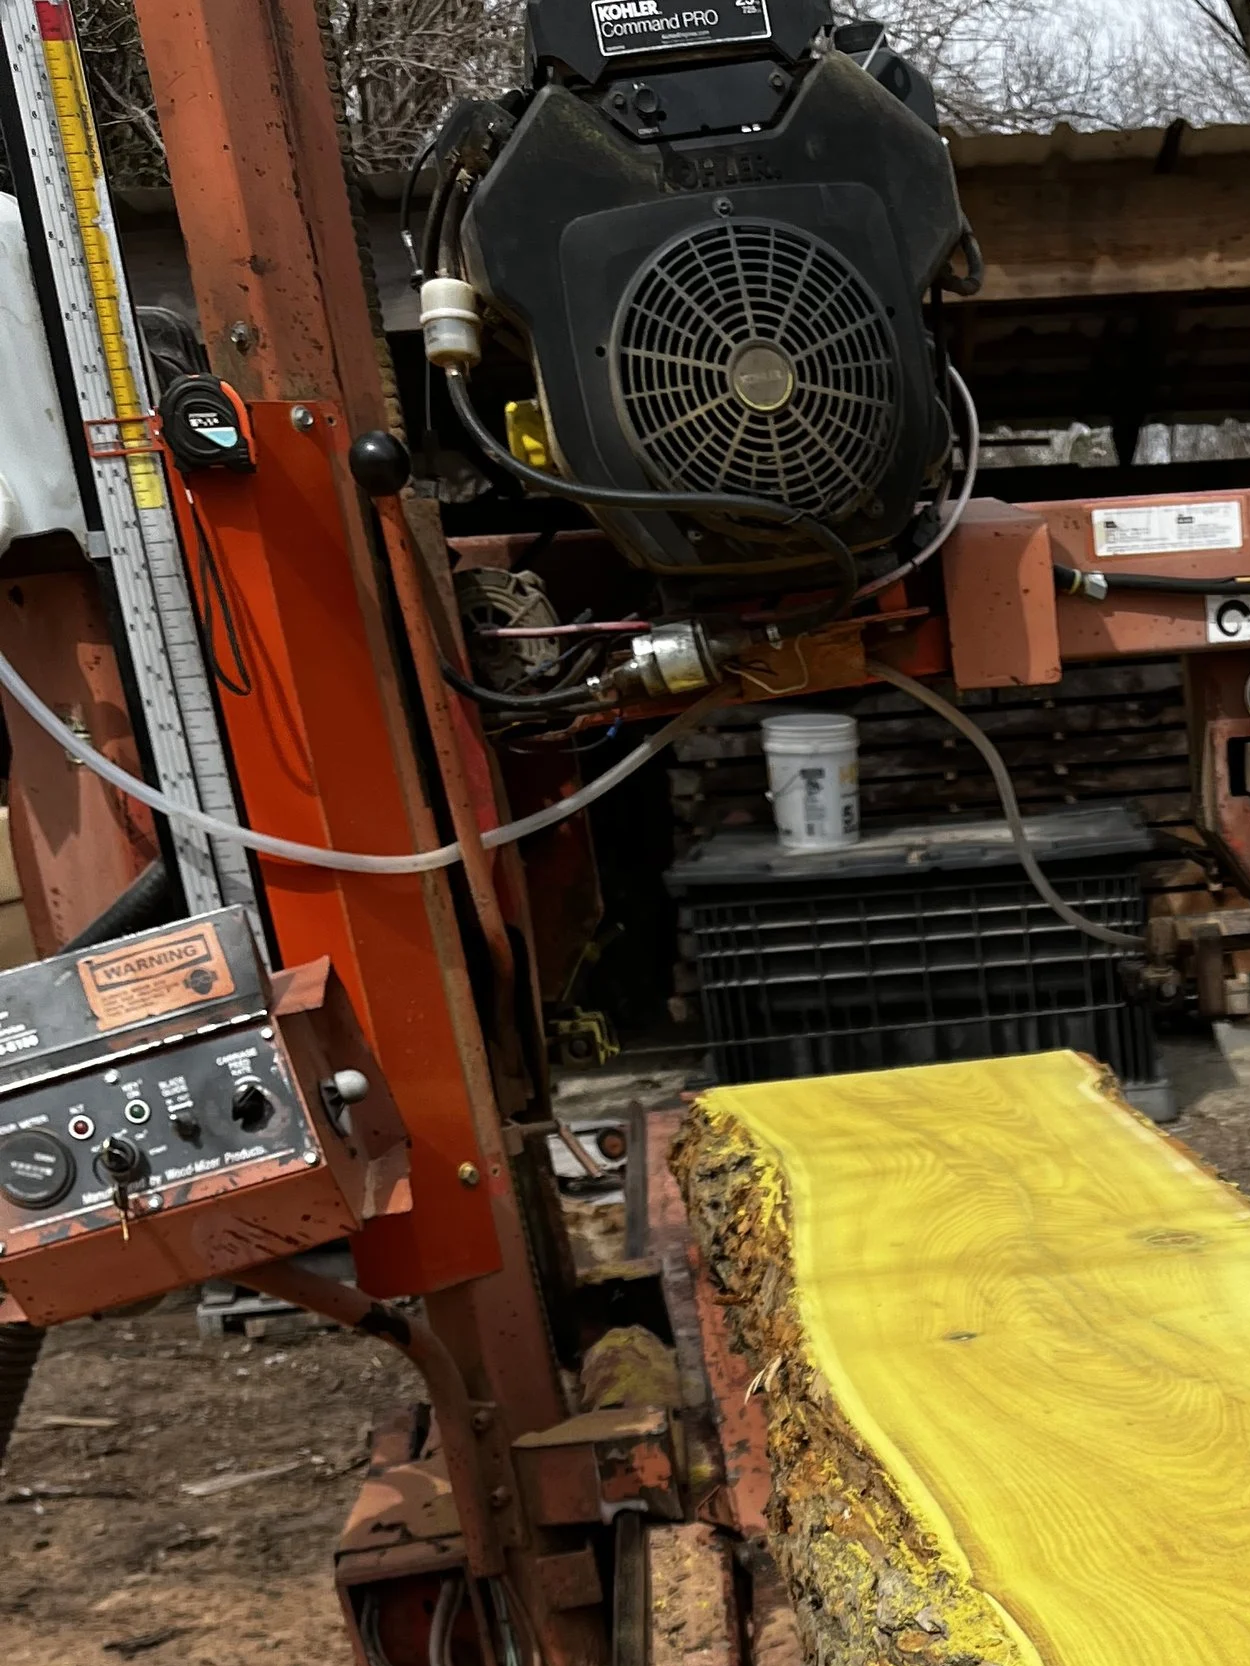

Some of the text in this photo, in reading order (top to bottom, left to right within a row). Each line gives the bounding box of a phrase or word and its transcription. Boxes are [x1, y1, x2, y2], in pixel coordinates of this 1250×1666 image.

[599, 2, 658, 21] KOHLER
[601, 15, 680, 38] Command
[682, 9, 719, 28] PRO
[103, 944, 197, 980] WARNING
[164, 1156, 221, 1181] Wood-Mizer
[224, 1145, 267, 1165] Products
